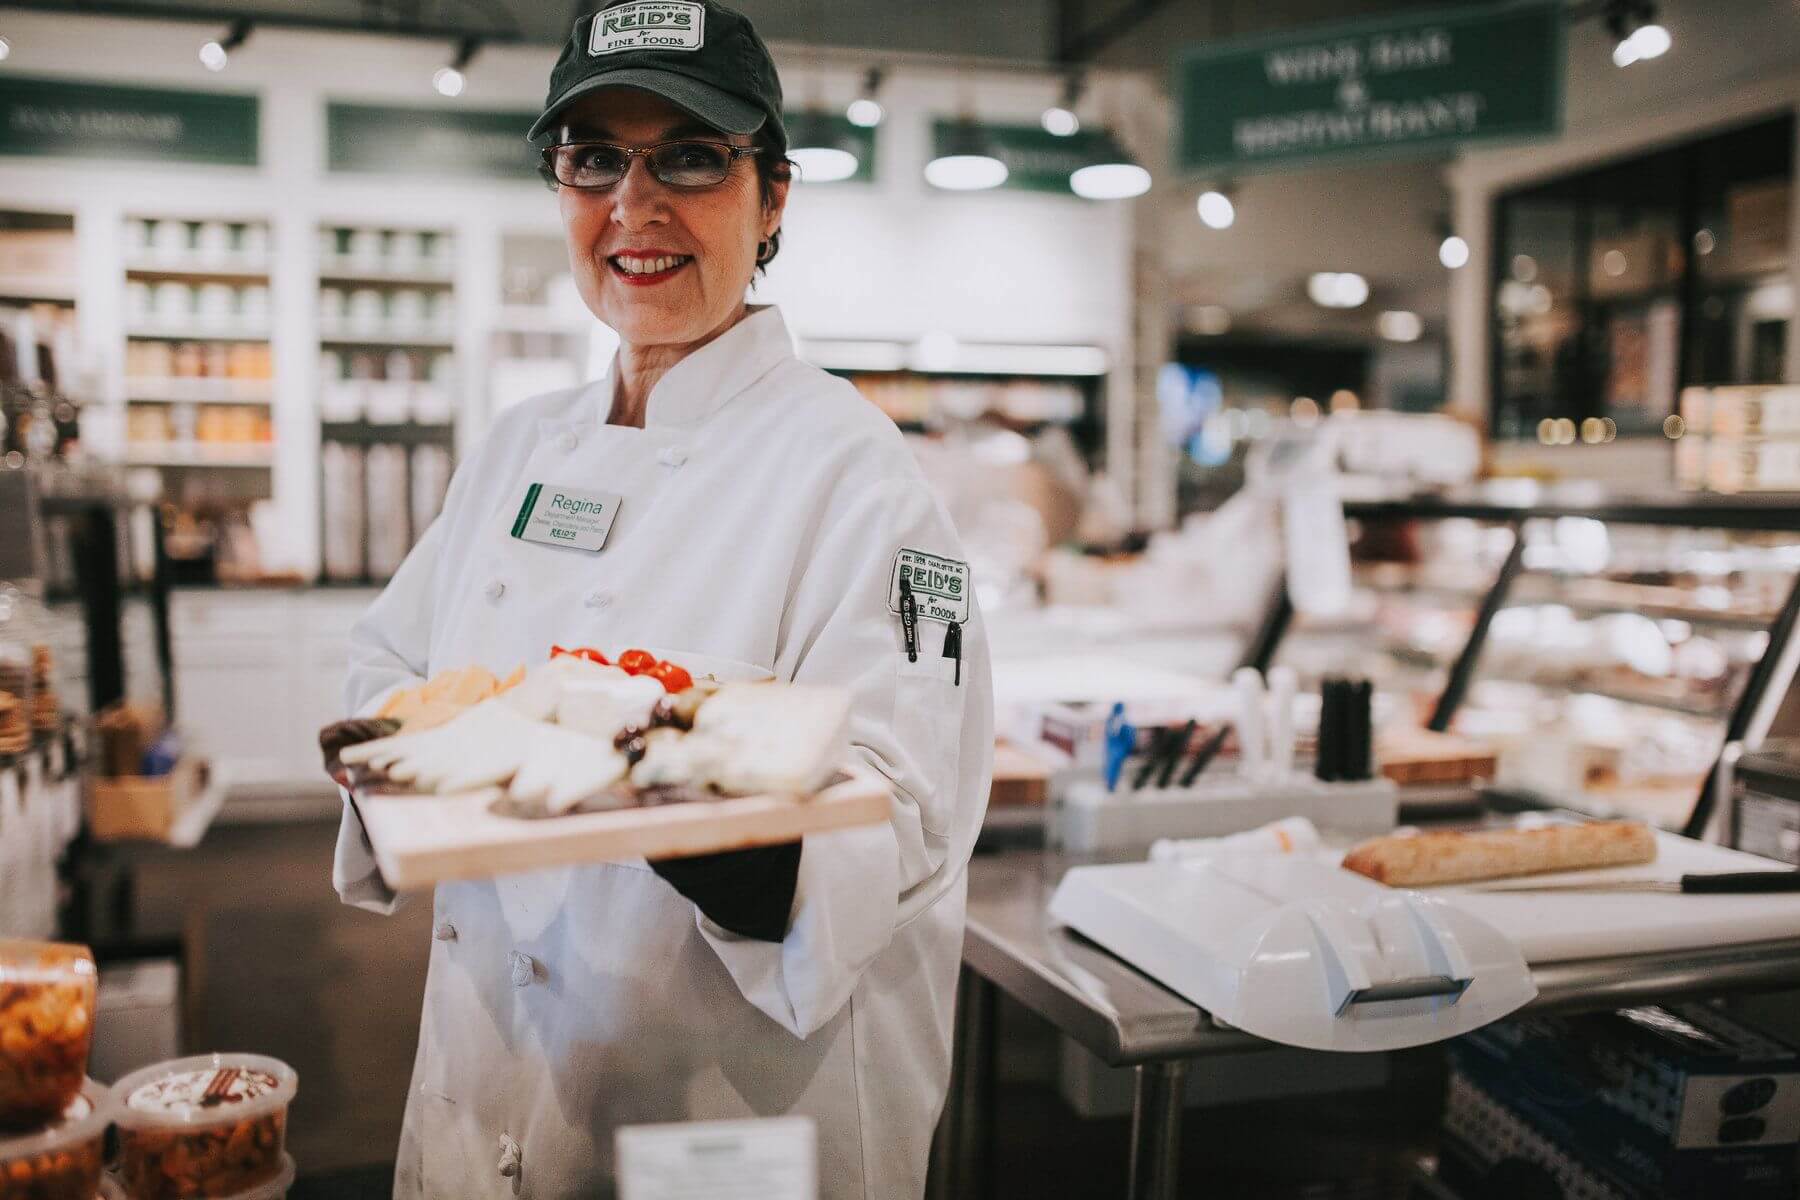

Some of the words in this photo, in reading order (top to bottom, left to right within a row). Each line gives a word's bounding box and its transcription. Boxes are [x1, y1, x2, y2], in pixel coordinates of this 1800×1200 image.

[602, 12, 691, 36] REID'S
[607, 38, 634, 48] FINE
[643, 37, 684, 45] FOODS
[1265, 46, 1358, 83] WINE
[1371, 32, 1450, 71] BAR
[1233, 93, 1485, 150] RESTAURANT
[551, 493, 603, 515] Regina
[550, 528, 577, 540] REID'S
[927, 596, 938, 605] for
[930, 606, 956, 620] FOODS
